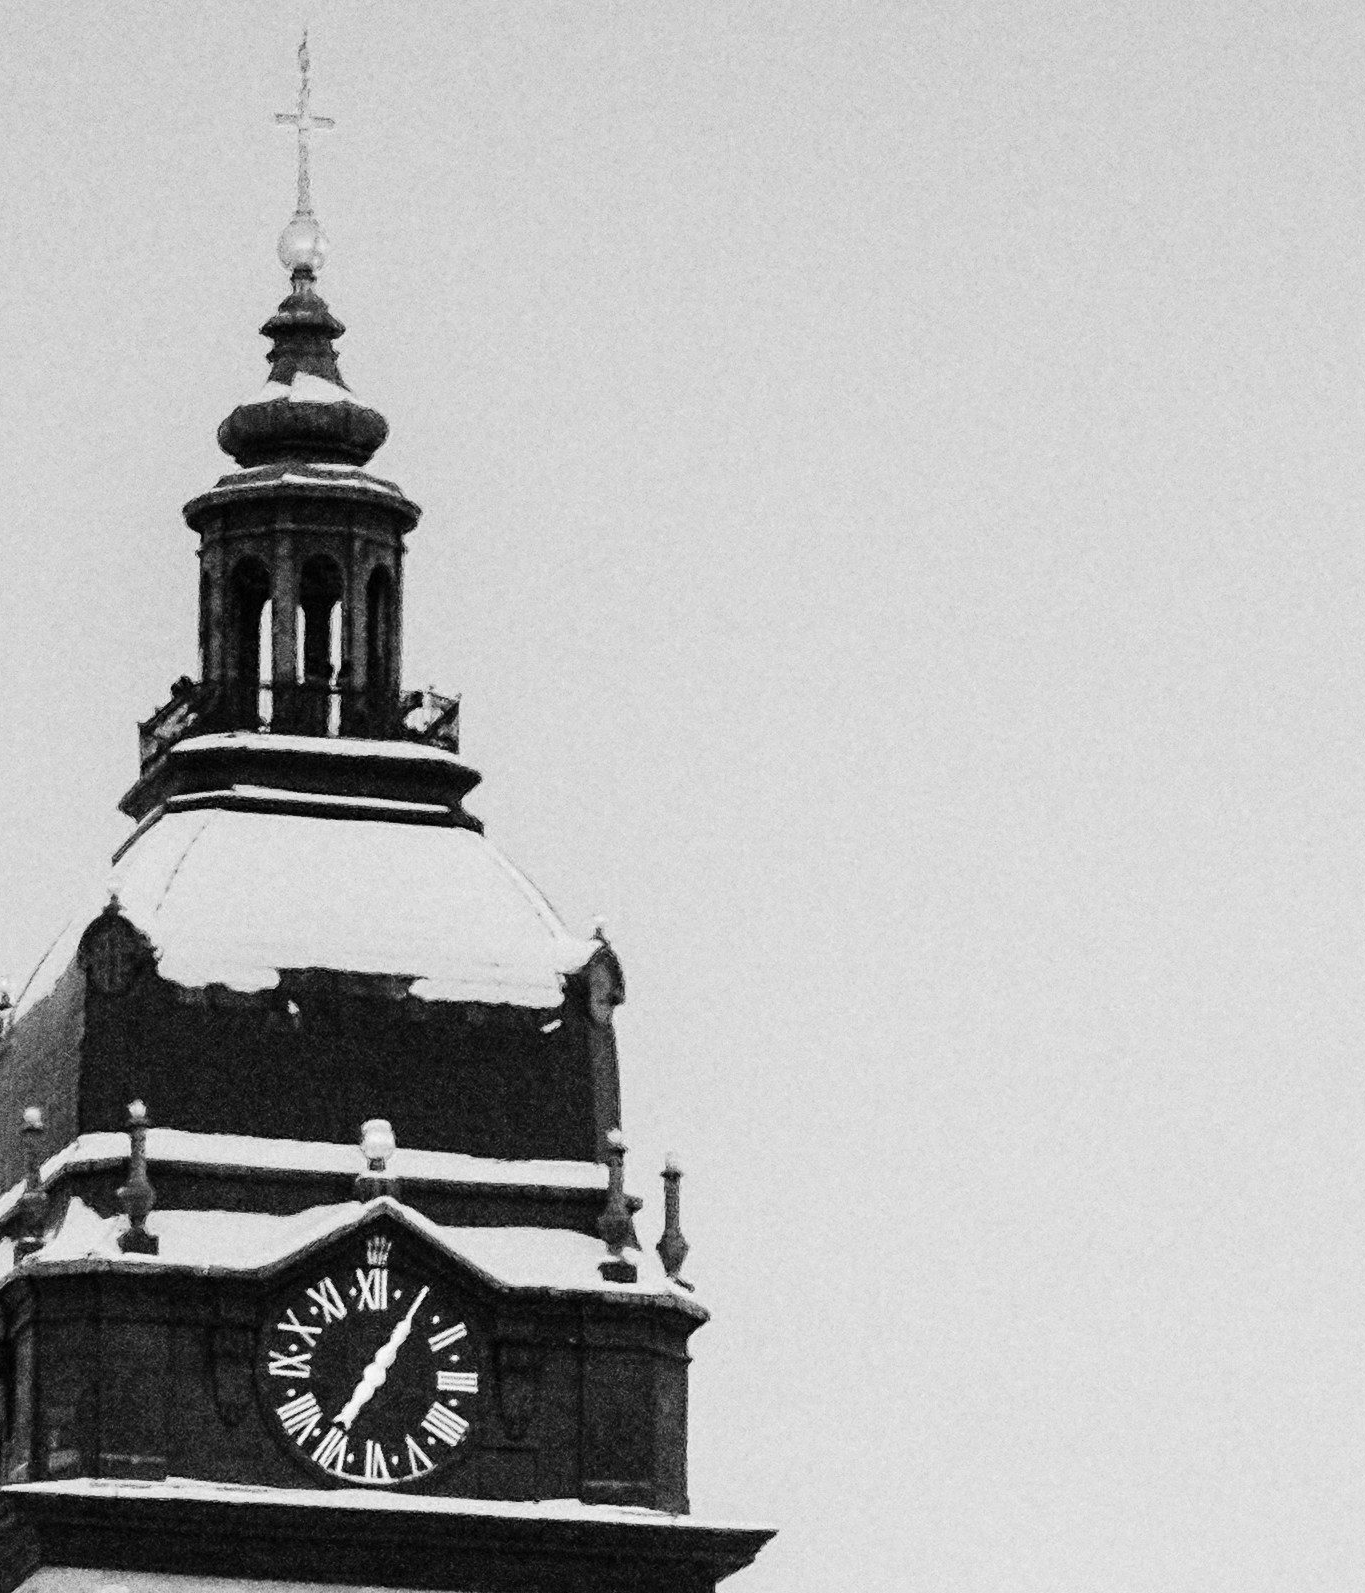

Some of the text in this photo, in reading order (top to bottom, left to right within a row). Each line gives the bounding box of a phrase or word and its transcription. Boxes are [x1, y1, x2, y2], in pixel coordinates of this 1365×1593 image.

[305, 1277, 347, 1323] XI
[356, 1268, 388, 1311] XII
[277, 1308, 323, 1347] X
[427, 1322, 468, 1352] II
[268, 1350, 312, 1379] IX
[436, 1370, 479, 1393] III
[405, 1433, 436, 1474] V
